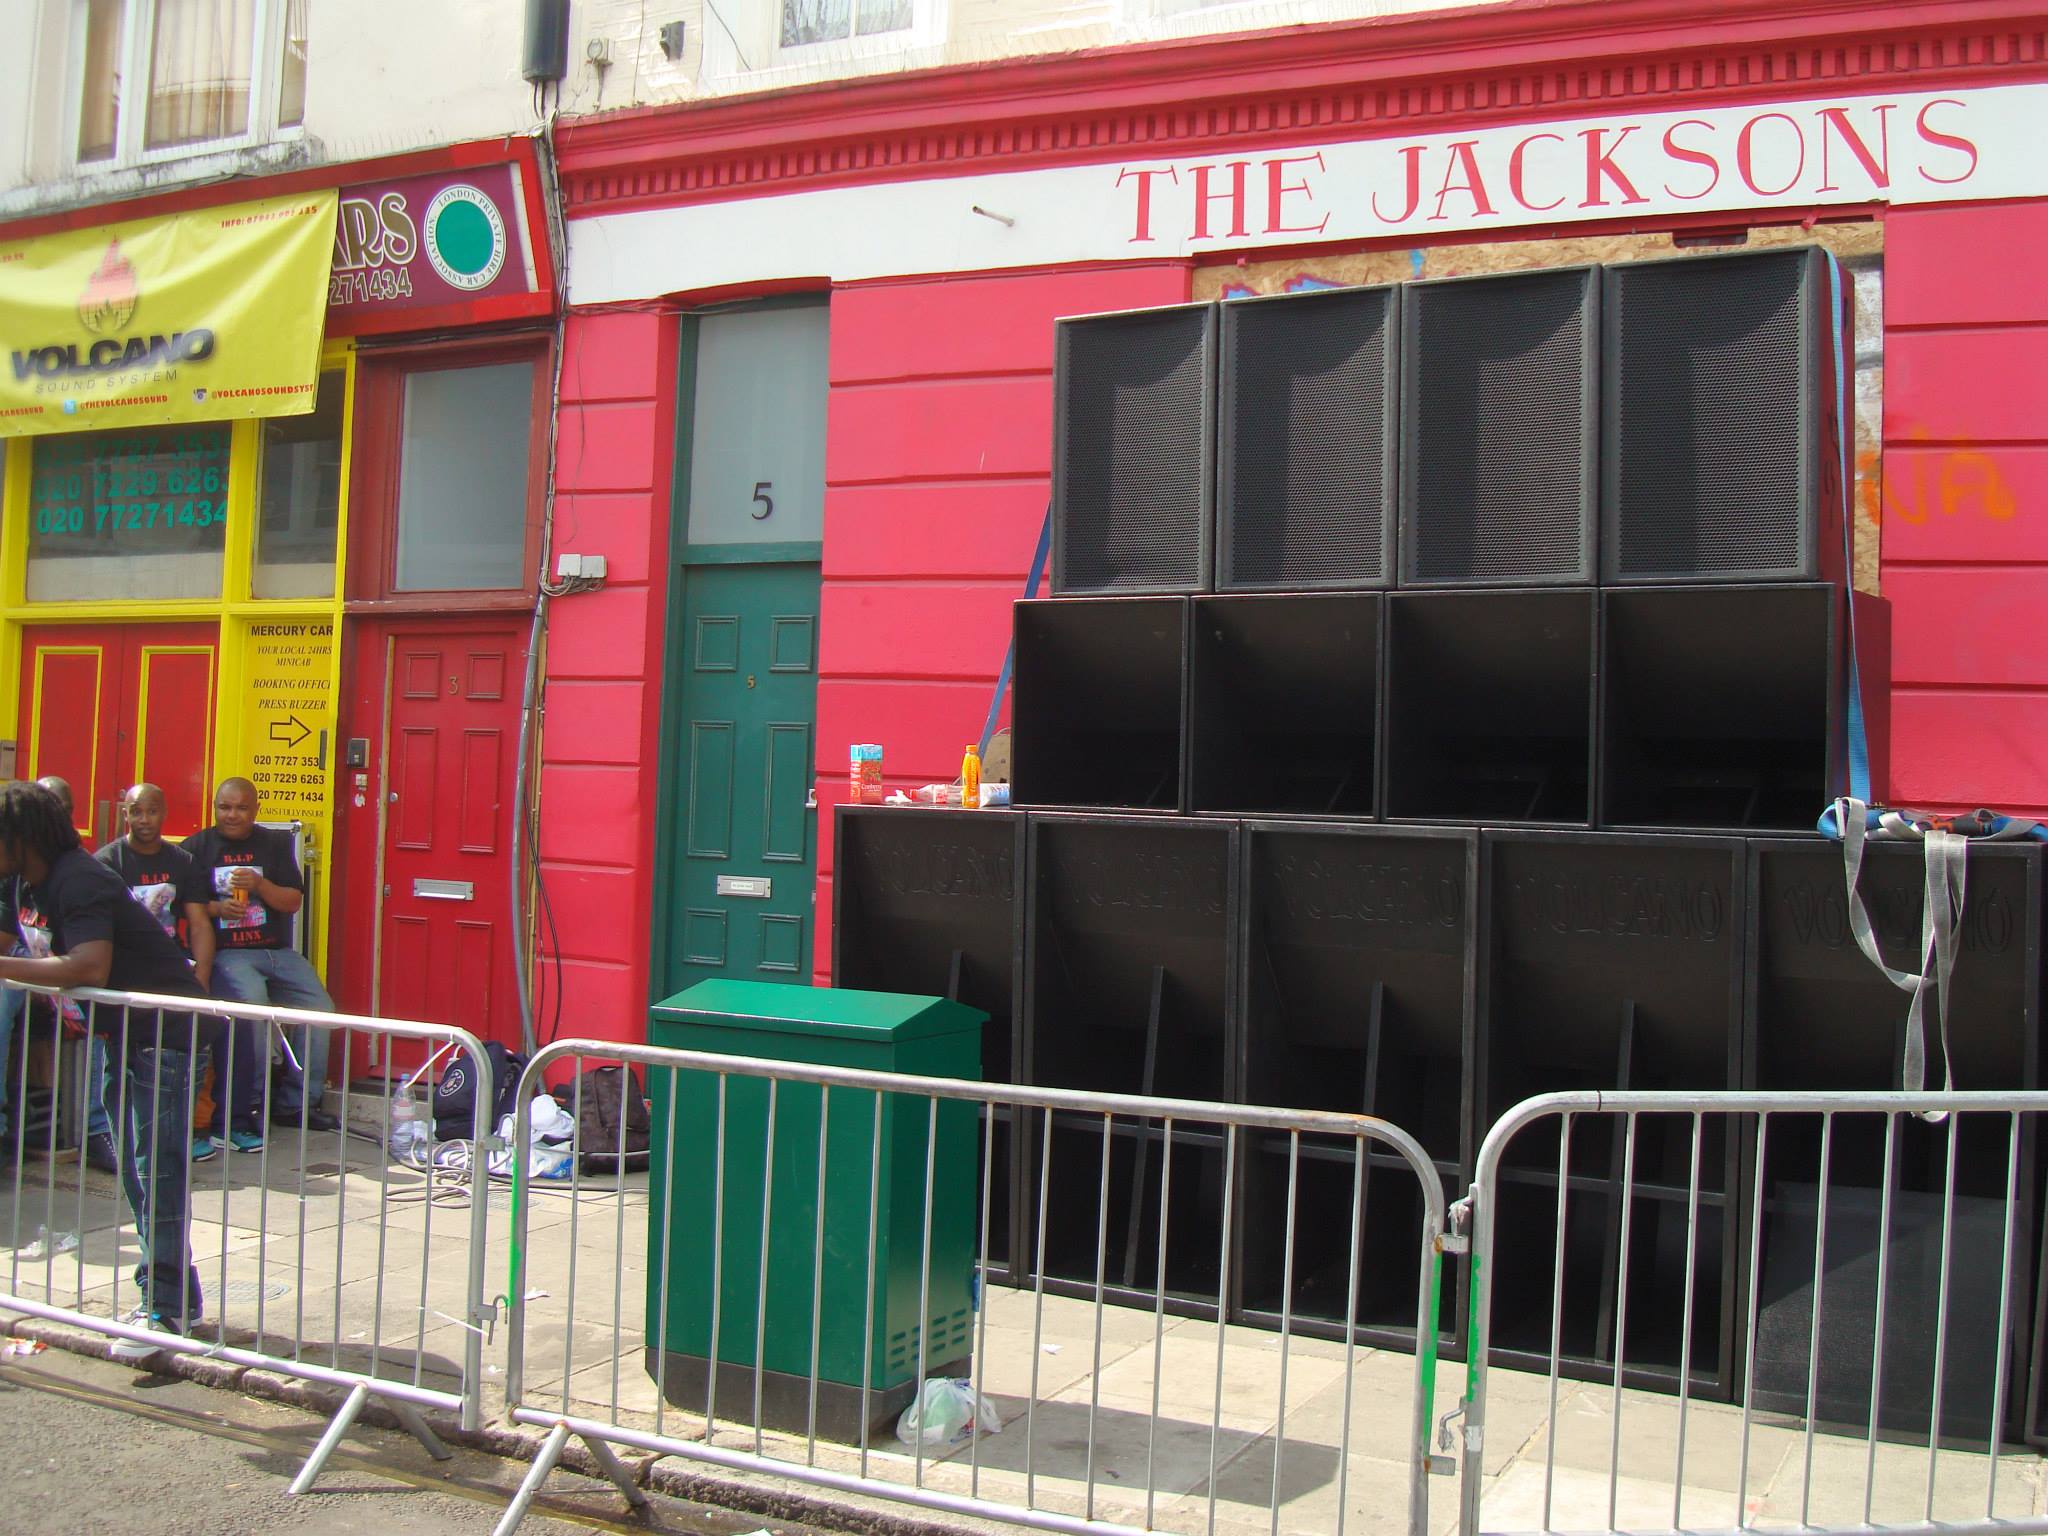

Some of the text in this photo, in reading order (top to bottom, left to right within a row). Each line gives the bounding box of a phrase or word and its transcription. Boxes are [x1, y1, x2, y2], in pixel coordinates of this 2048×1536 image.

[1116, 99, 1979, 242] THE JACKSONS
[427, 189, 502, 286] LONDON PRIVATE HIRE CAR ASSOCIATION
[11, 328, 215, 383] VOLCANO
[35, 369, 178, 394] SOUND SYSTEM
[35, 474, 82, 500] 020
[94, 470, 157, 498] 7229
[751, 481, 775, 521] 5
[36, 506, 84, 534] 020
[251, 625, 306, 636] MERCURY
[257, 645, 279, 655] YOUR
[280, 645, 306, 655] LOCAL
[276, 657, 312, 667] MINICAB
[253, 679, 295, 689] BOOKING
[448, 675, 458, 695] 3
[747, 674, 757, 689] 5
[258, 699, 327, 710] PRESS BUZZER
[254, 755, 319, 767] 020 7727 353
[253, 772, 325, 784] 020 7229 6263
[258, 790, 324, 802] 20 7727 1434
